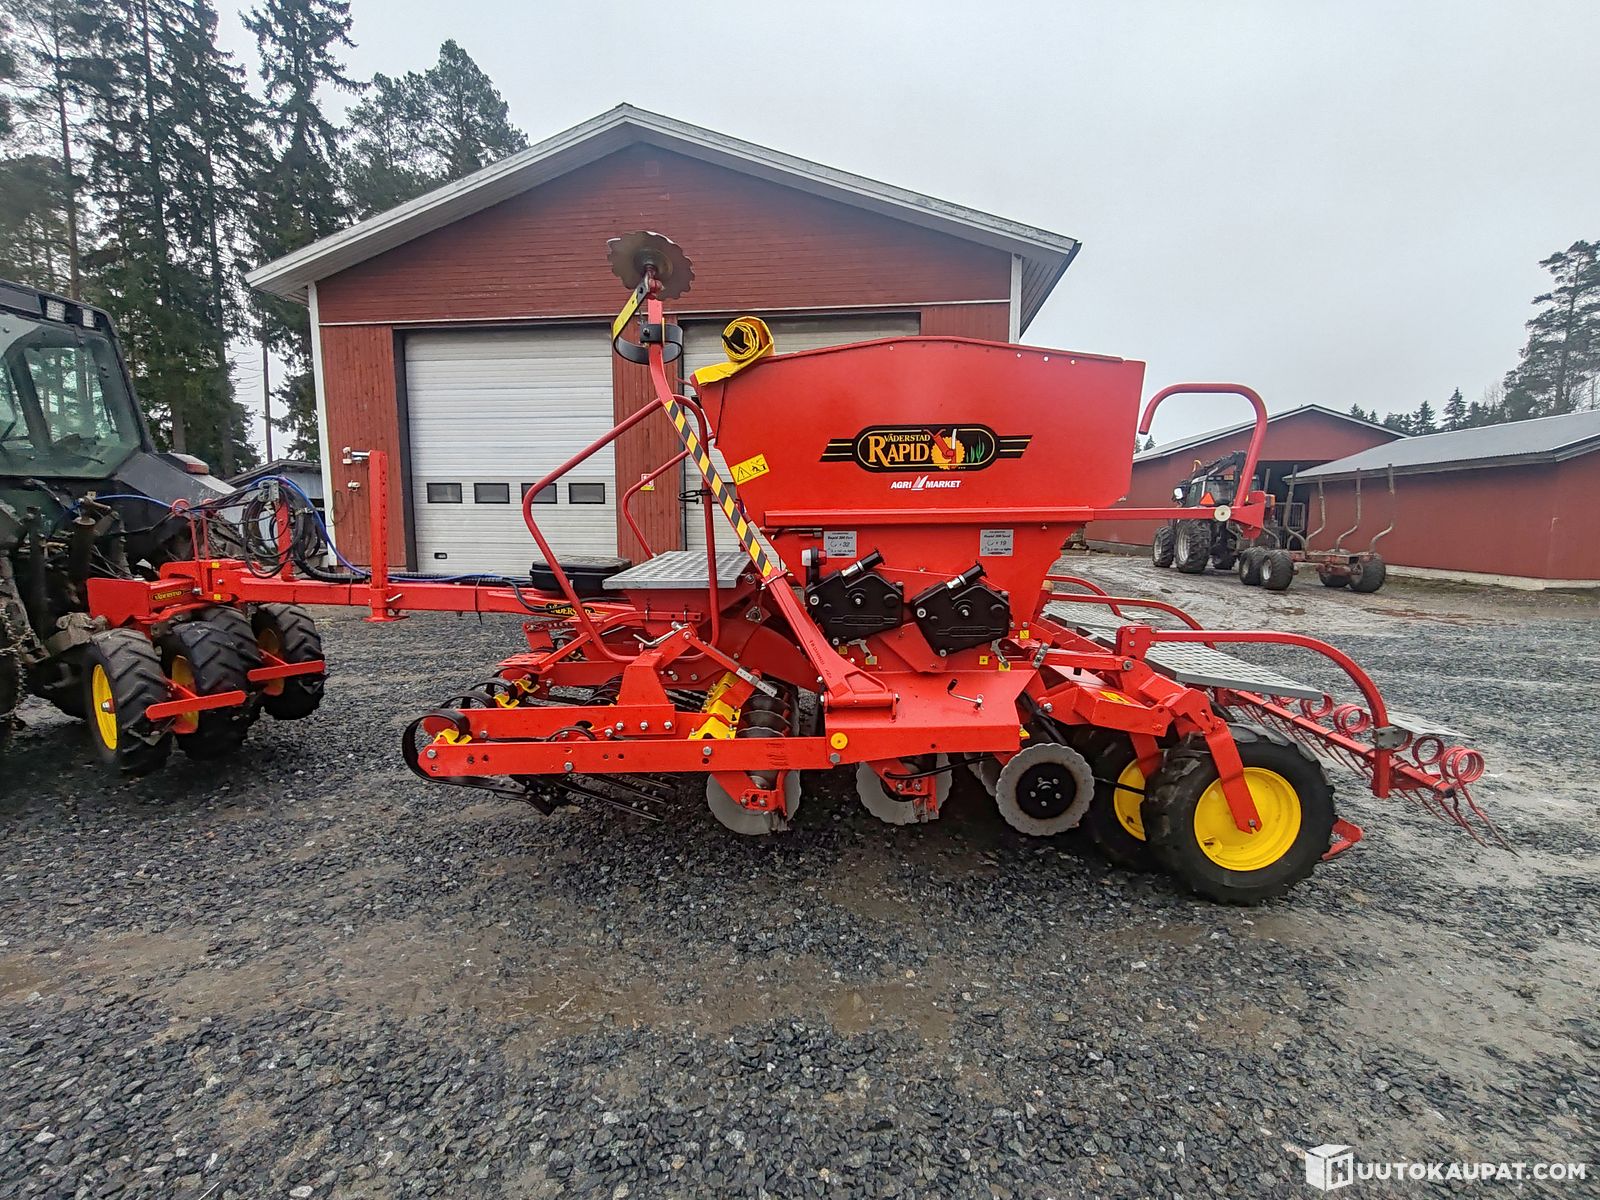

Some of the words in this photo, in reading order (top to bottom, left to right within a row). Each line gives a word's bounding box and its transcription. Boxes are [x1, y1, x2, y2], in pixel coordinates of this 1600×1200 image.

[884, 433, 931, 442] VÄDERSTAD
[868, 436, 929, 467] RAPID
[890, 481, 912, 489] AGRI
[925, 480, 961, 489] MARKET
